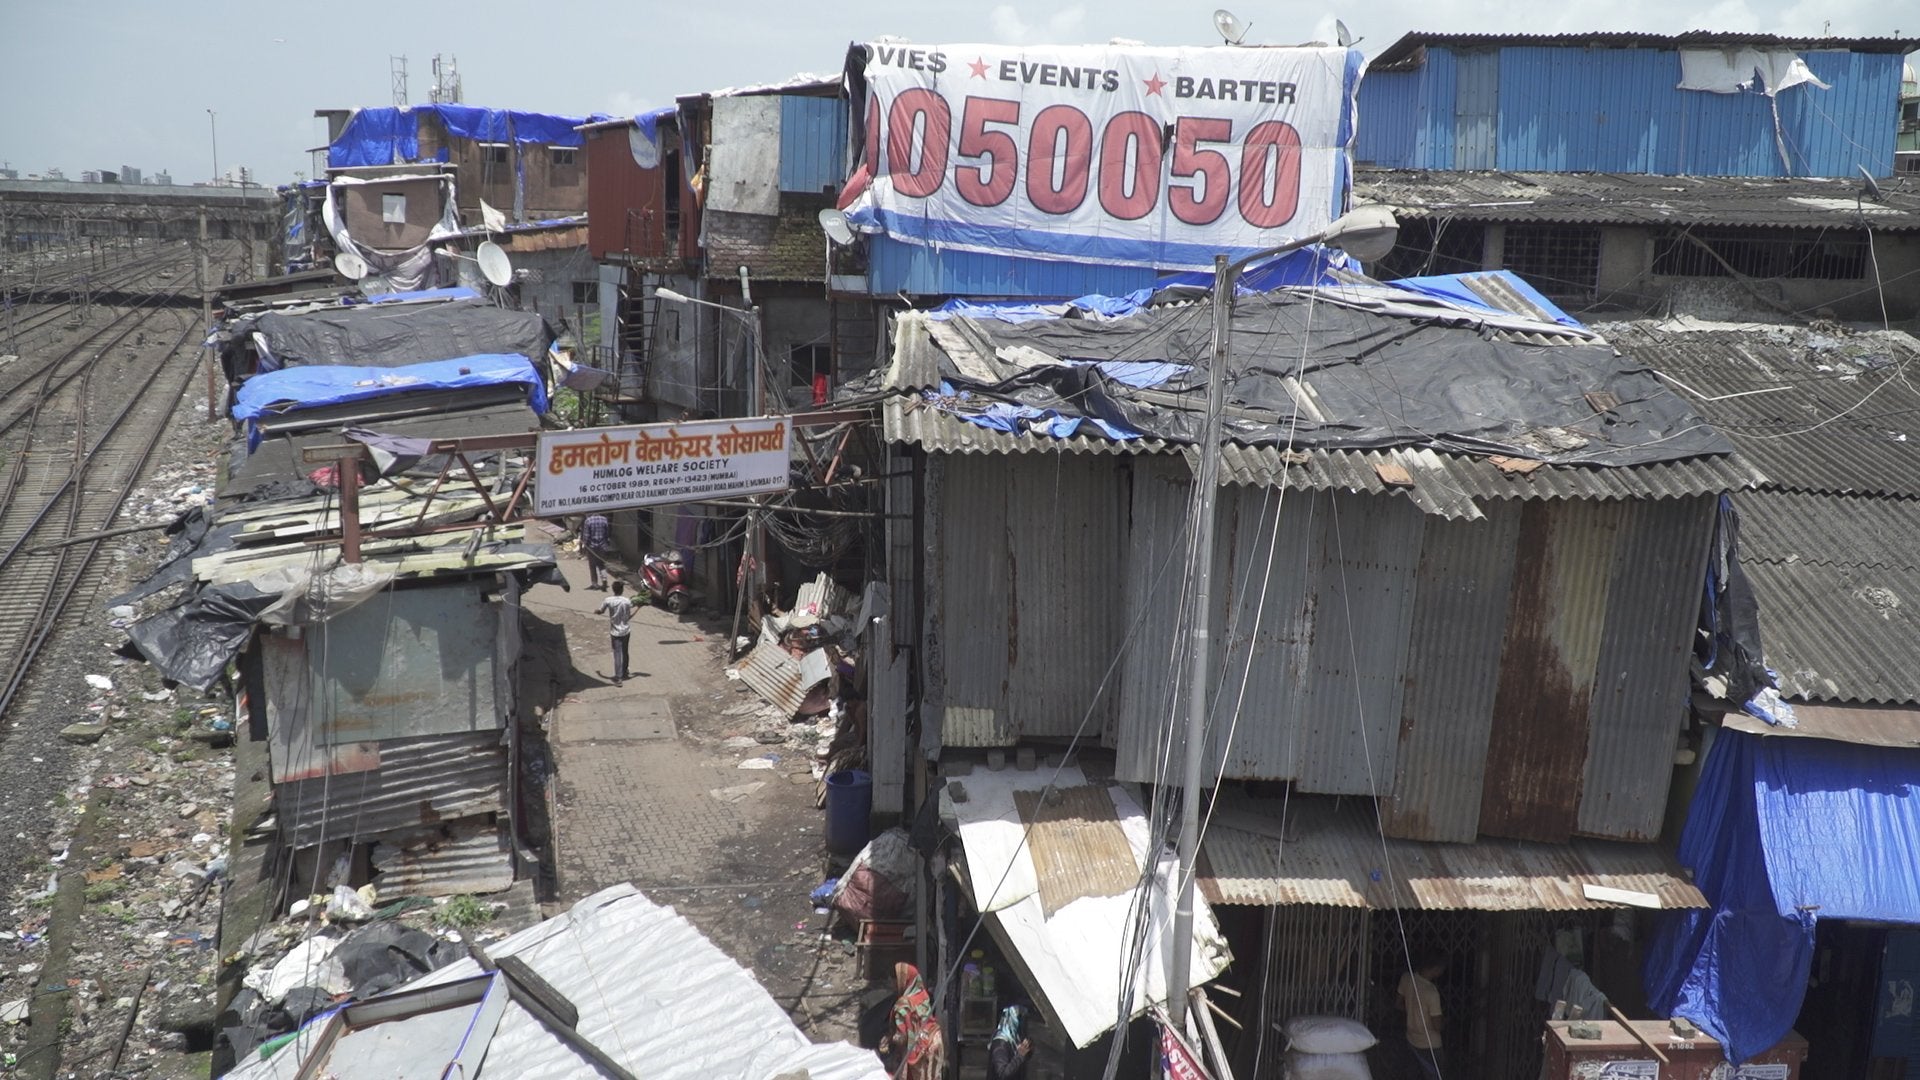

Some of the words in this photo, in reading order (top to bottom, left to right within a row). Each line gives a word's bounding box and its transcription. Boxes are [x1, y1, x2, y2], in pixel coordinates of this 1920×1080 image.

[999, 60, 1119, 92] EVENTS
[1175, 77, 1297, 105] BARTER
[549, 433, 631, 475] हमलोग
[636, 429, 713, 461] वेलफेयर
[717, 422, 785, 456] सोसायटी
[593, 467, 633, 479] HUMLOG
[636, 462, 678, 475] WELFARE
[682, 458, 730, 472] SOCIETY
[579, 485, 588, 493] 16
[590, 481, 627, 492] OCTOBER
[541, 499, 556, 508] PLOT
